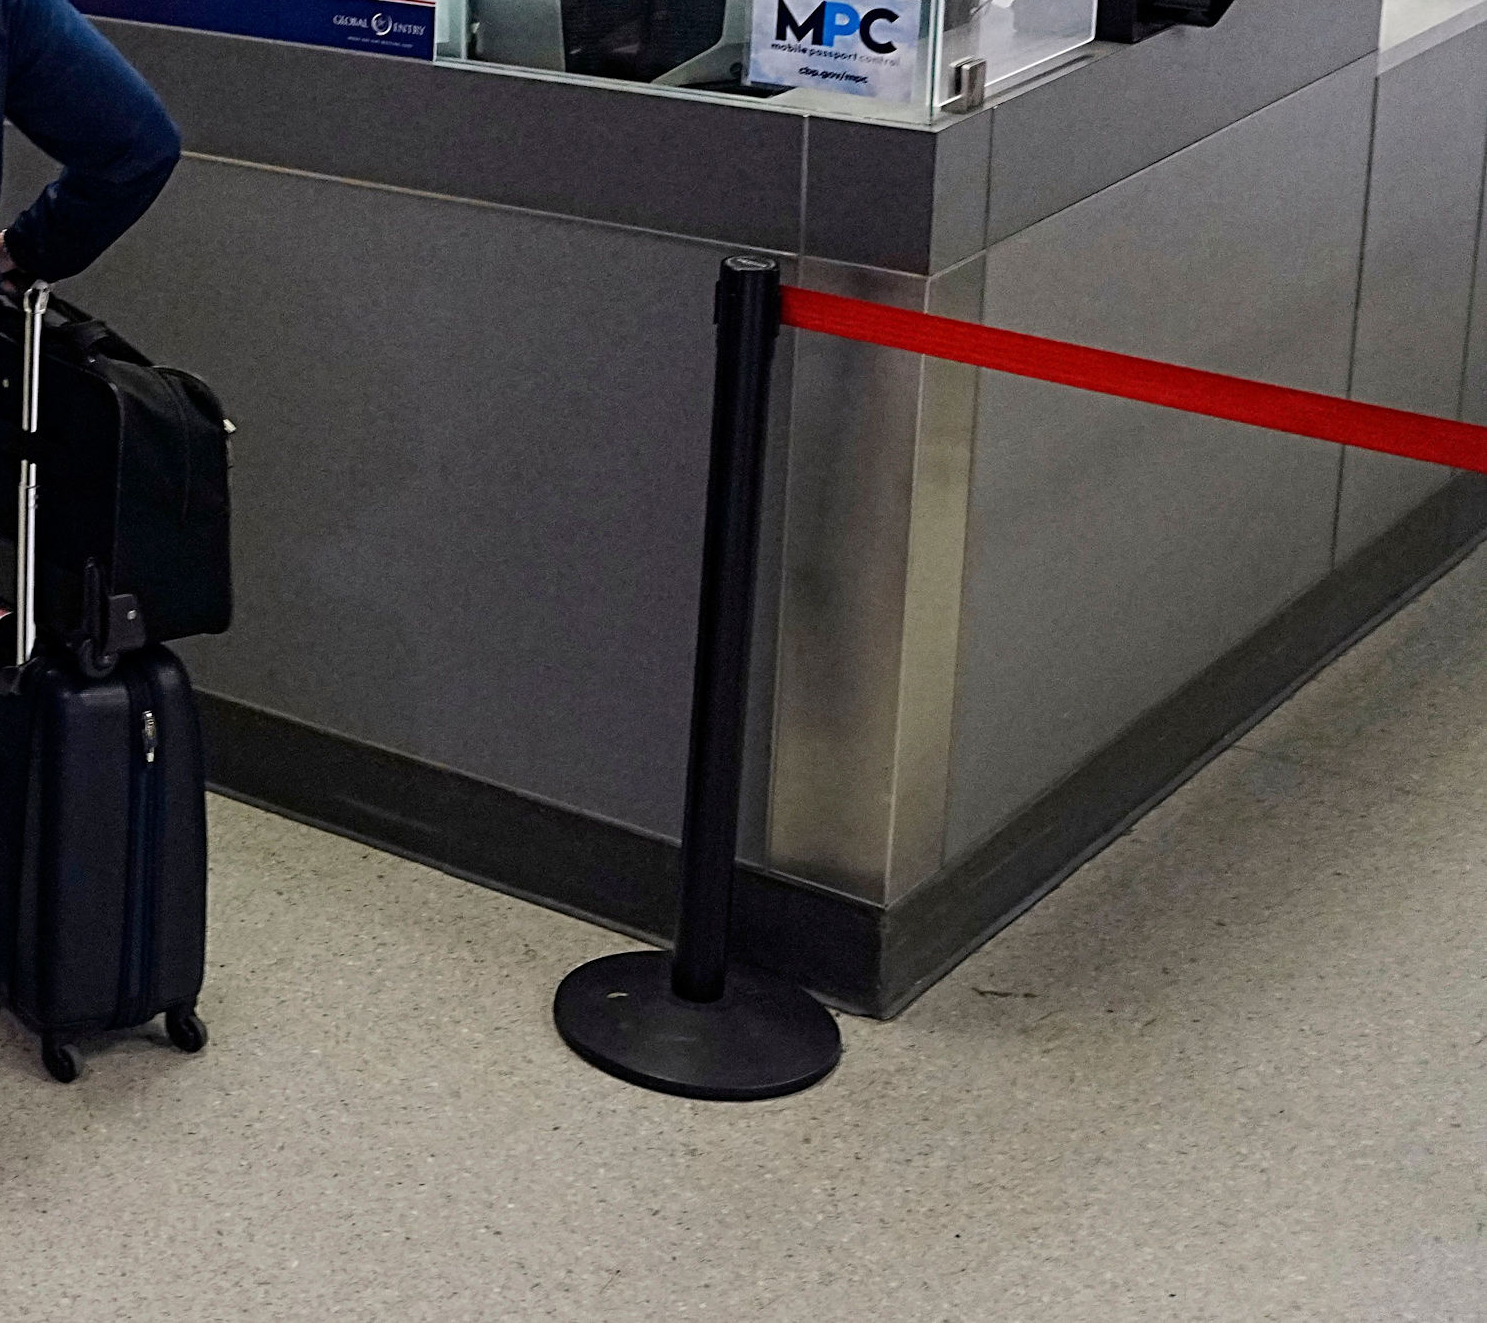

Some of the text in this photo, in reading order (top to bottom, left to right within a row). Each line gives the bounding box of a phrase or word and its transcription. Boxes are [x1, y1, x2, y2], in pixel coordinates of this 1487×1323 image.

[770, 41, 901, 68] mobile passport control
